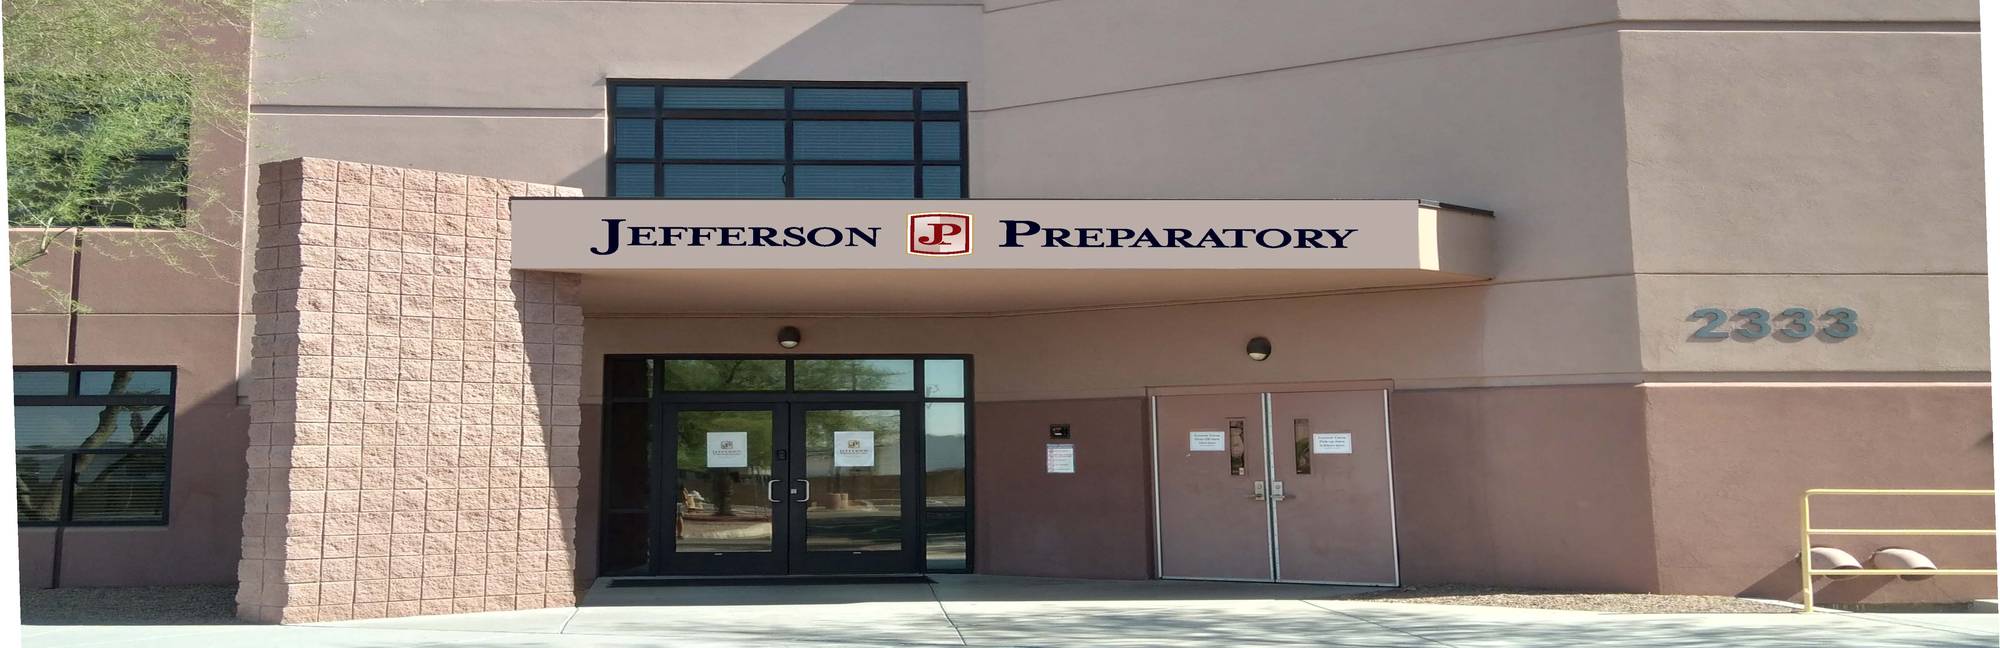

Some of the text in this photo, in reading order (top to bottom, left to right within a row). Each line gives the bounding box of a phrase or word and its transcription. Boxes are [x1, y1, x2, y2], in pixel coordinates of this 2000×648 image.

[590, 219, 1358, 255] JEFFERSON JP PREPARATORY
[1692, 307, 1859, 339] 2333
